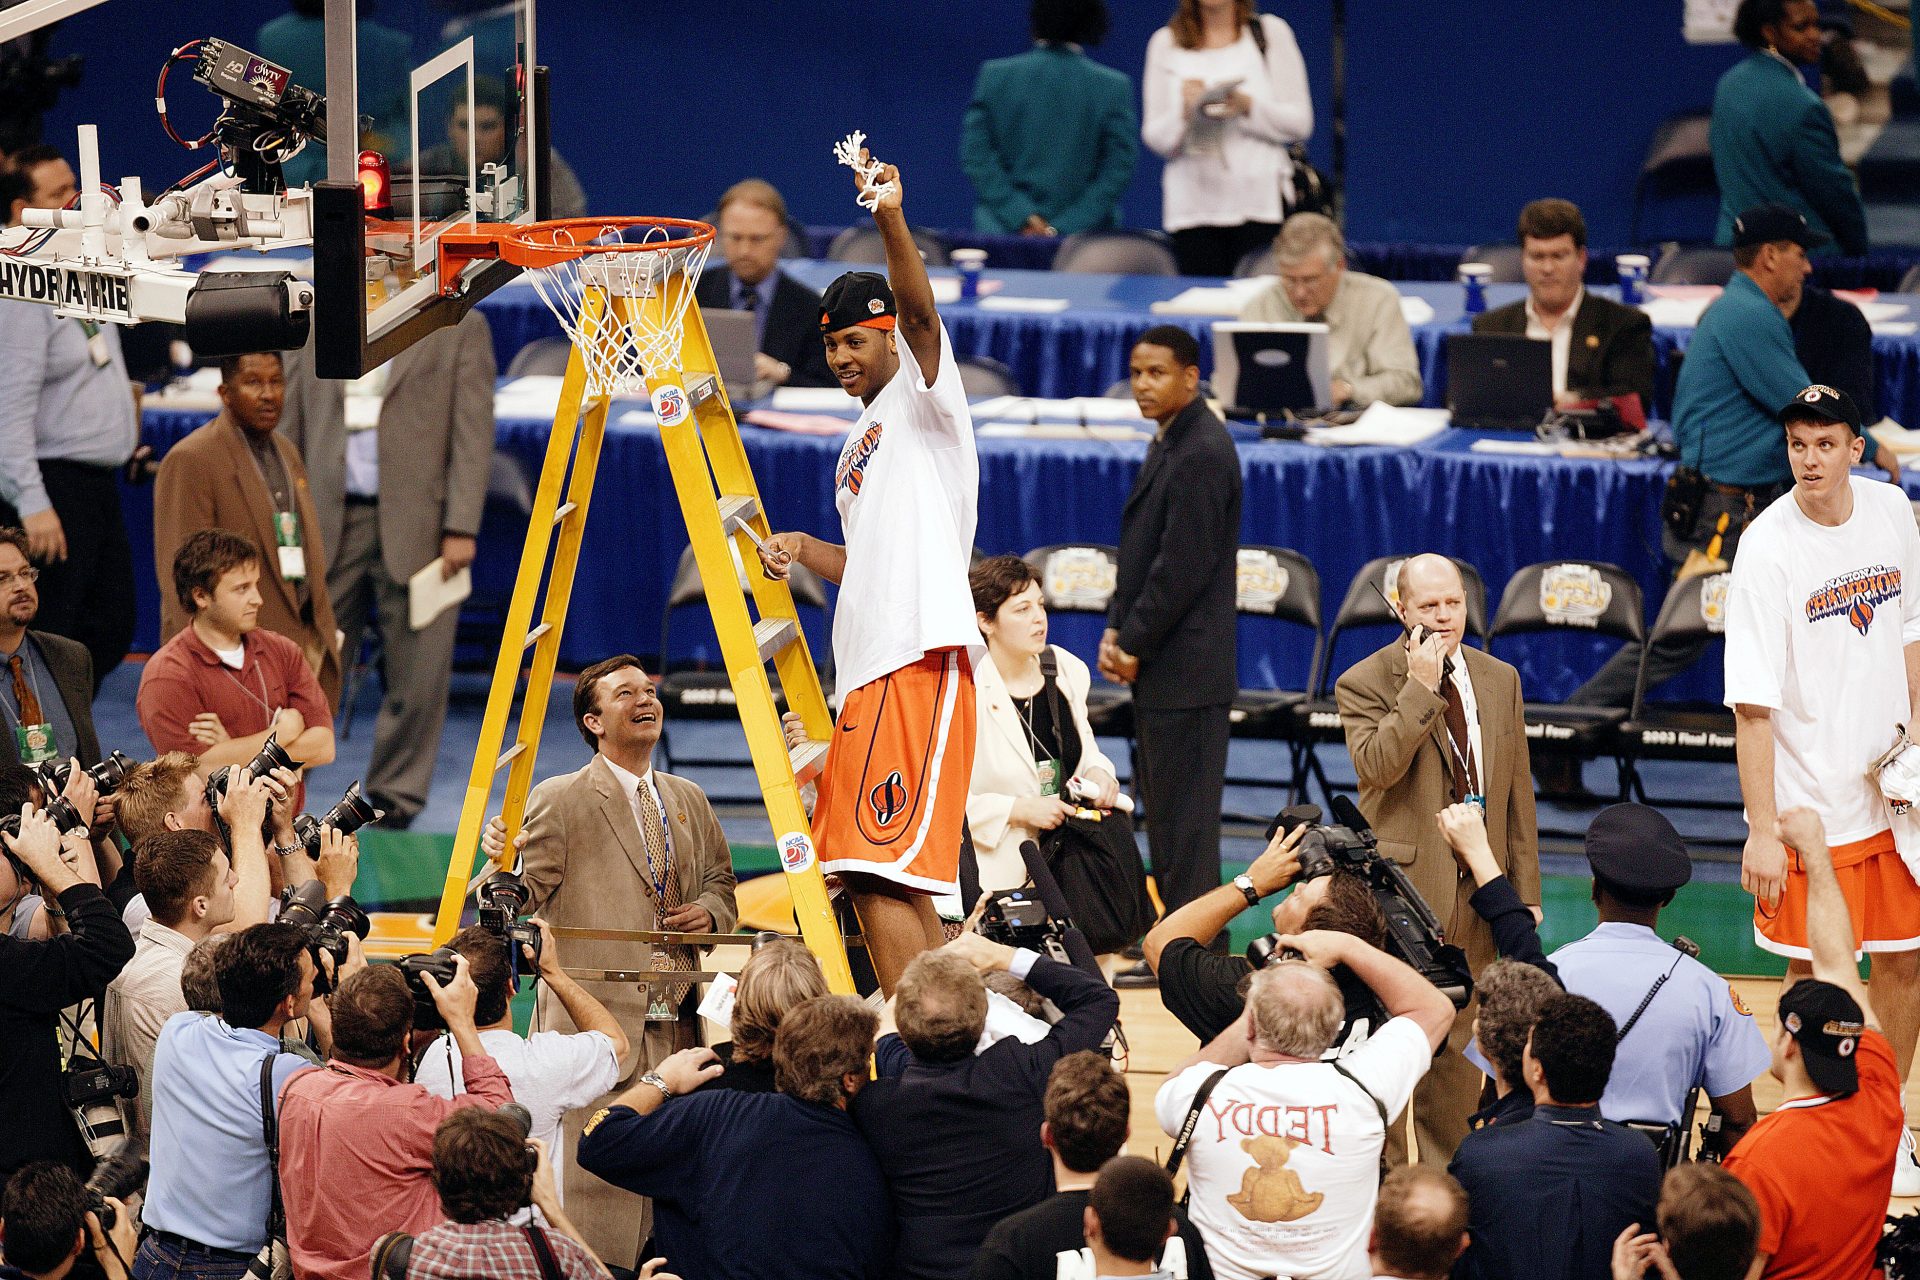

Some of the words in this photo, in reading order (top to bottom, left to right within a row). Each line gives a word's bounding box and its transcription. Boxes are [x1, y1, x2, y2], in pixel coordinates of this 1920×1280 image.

[253, 63, 282, 81] SWTV
[660, 388, 679, 399] NCAA
[1825, 564, 1886, 591] NATIONAL
[1805, 570, 1901, 622] CHAMPION
[1678, 731, 1708, 747] Final
[785, 835, 804, 847] NCAA
[1175, 1108, 1200, 1151] DIGITAL
